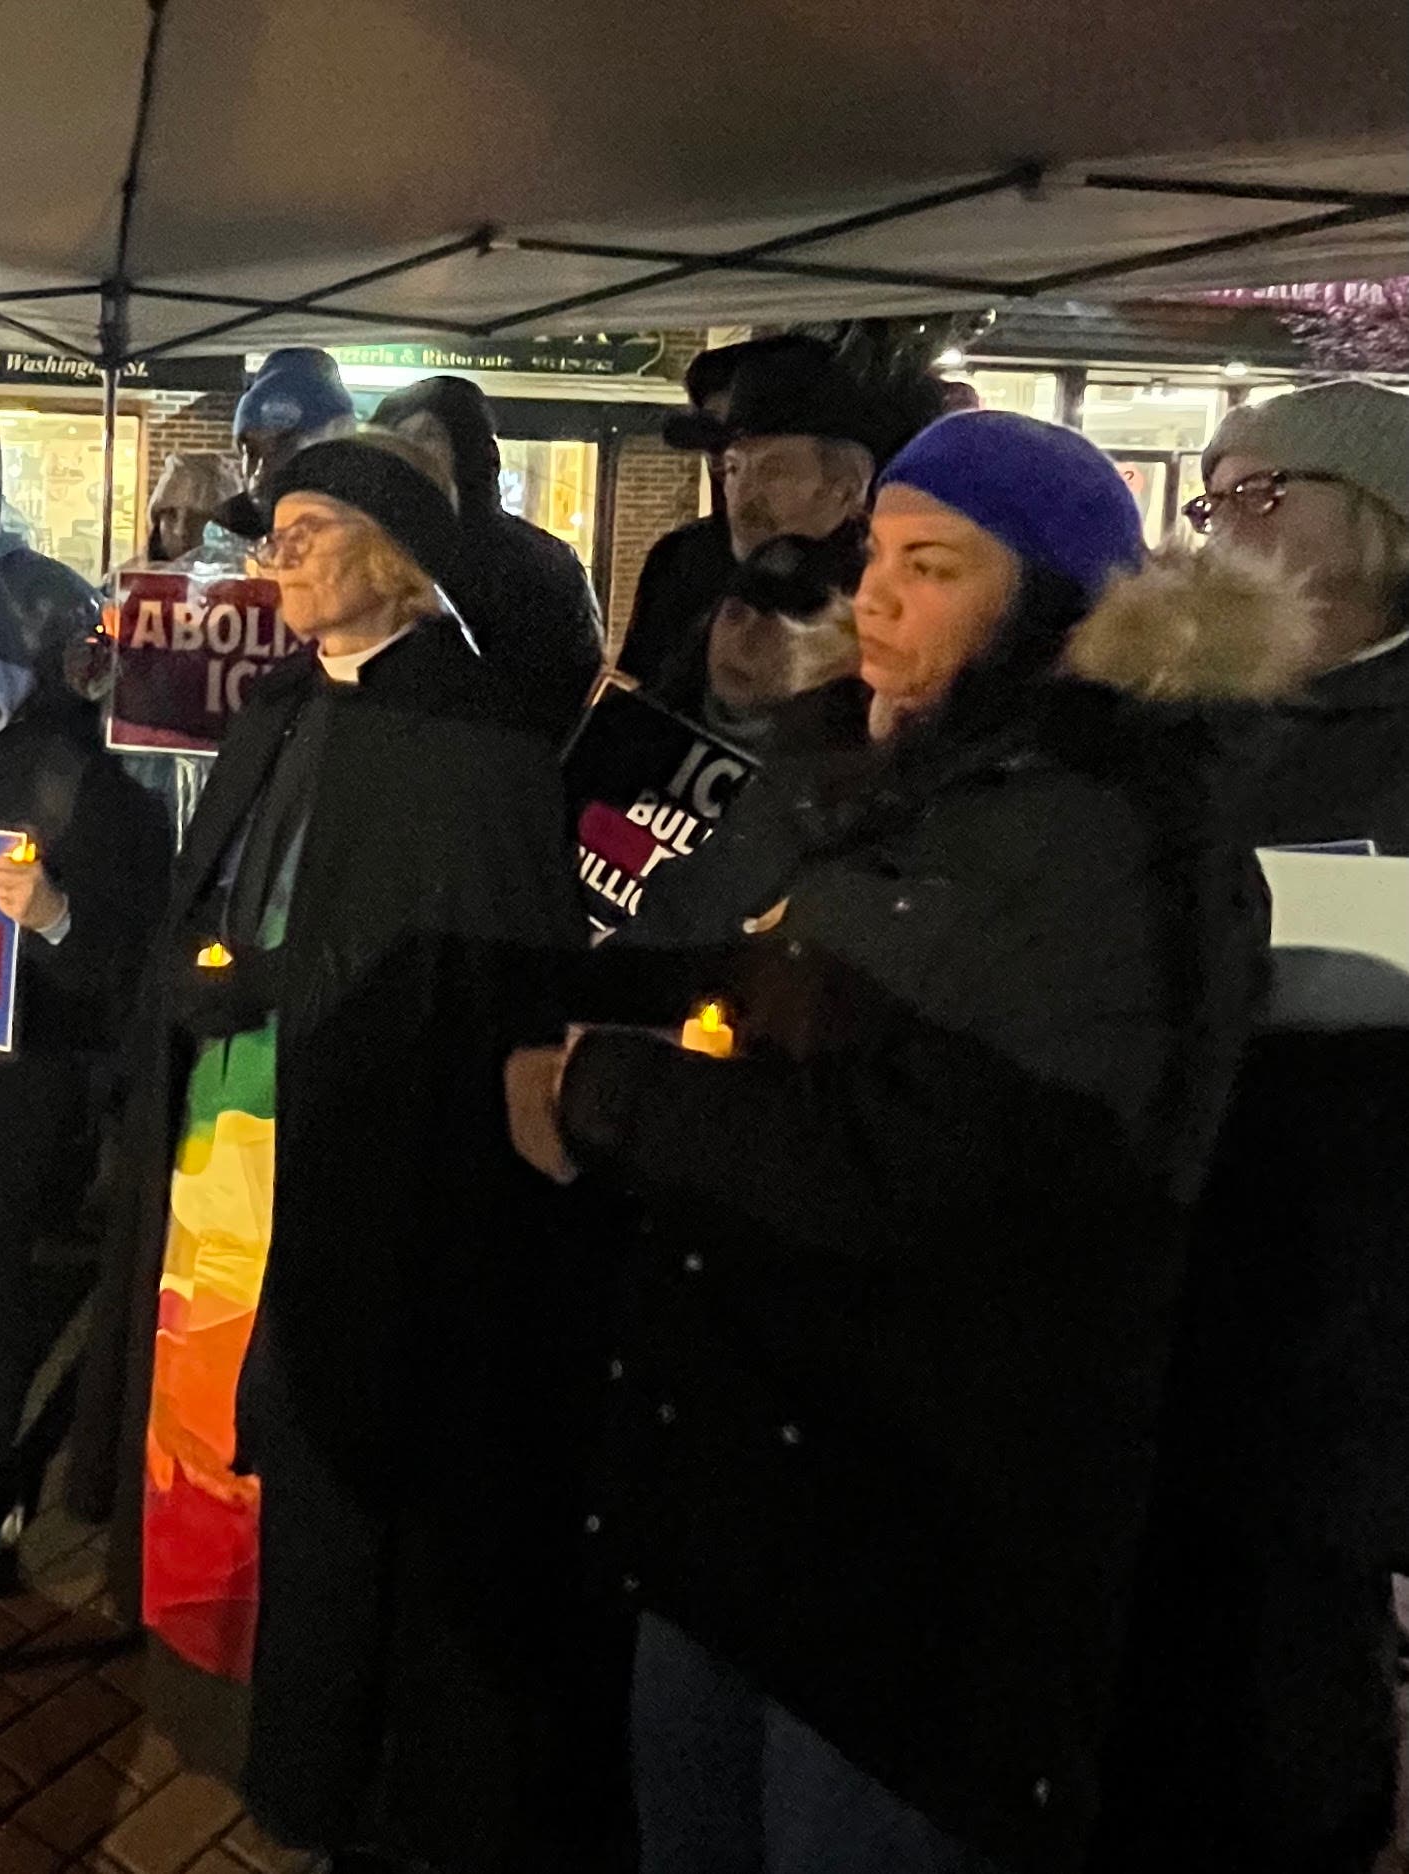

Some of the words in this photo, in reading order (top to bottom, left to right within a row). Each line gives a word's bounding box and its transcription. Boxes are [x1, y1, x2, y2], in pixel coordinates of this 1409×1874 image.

[130, 599, 300, 658] ABOLI
[205, 659, 275, 713] IC
[668, 740, 750, 819] IC
